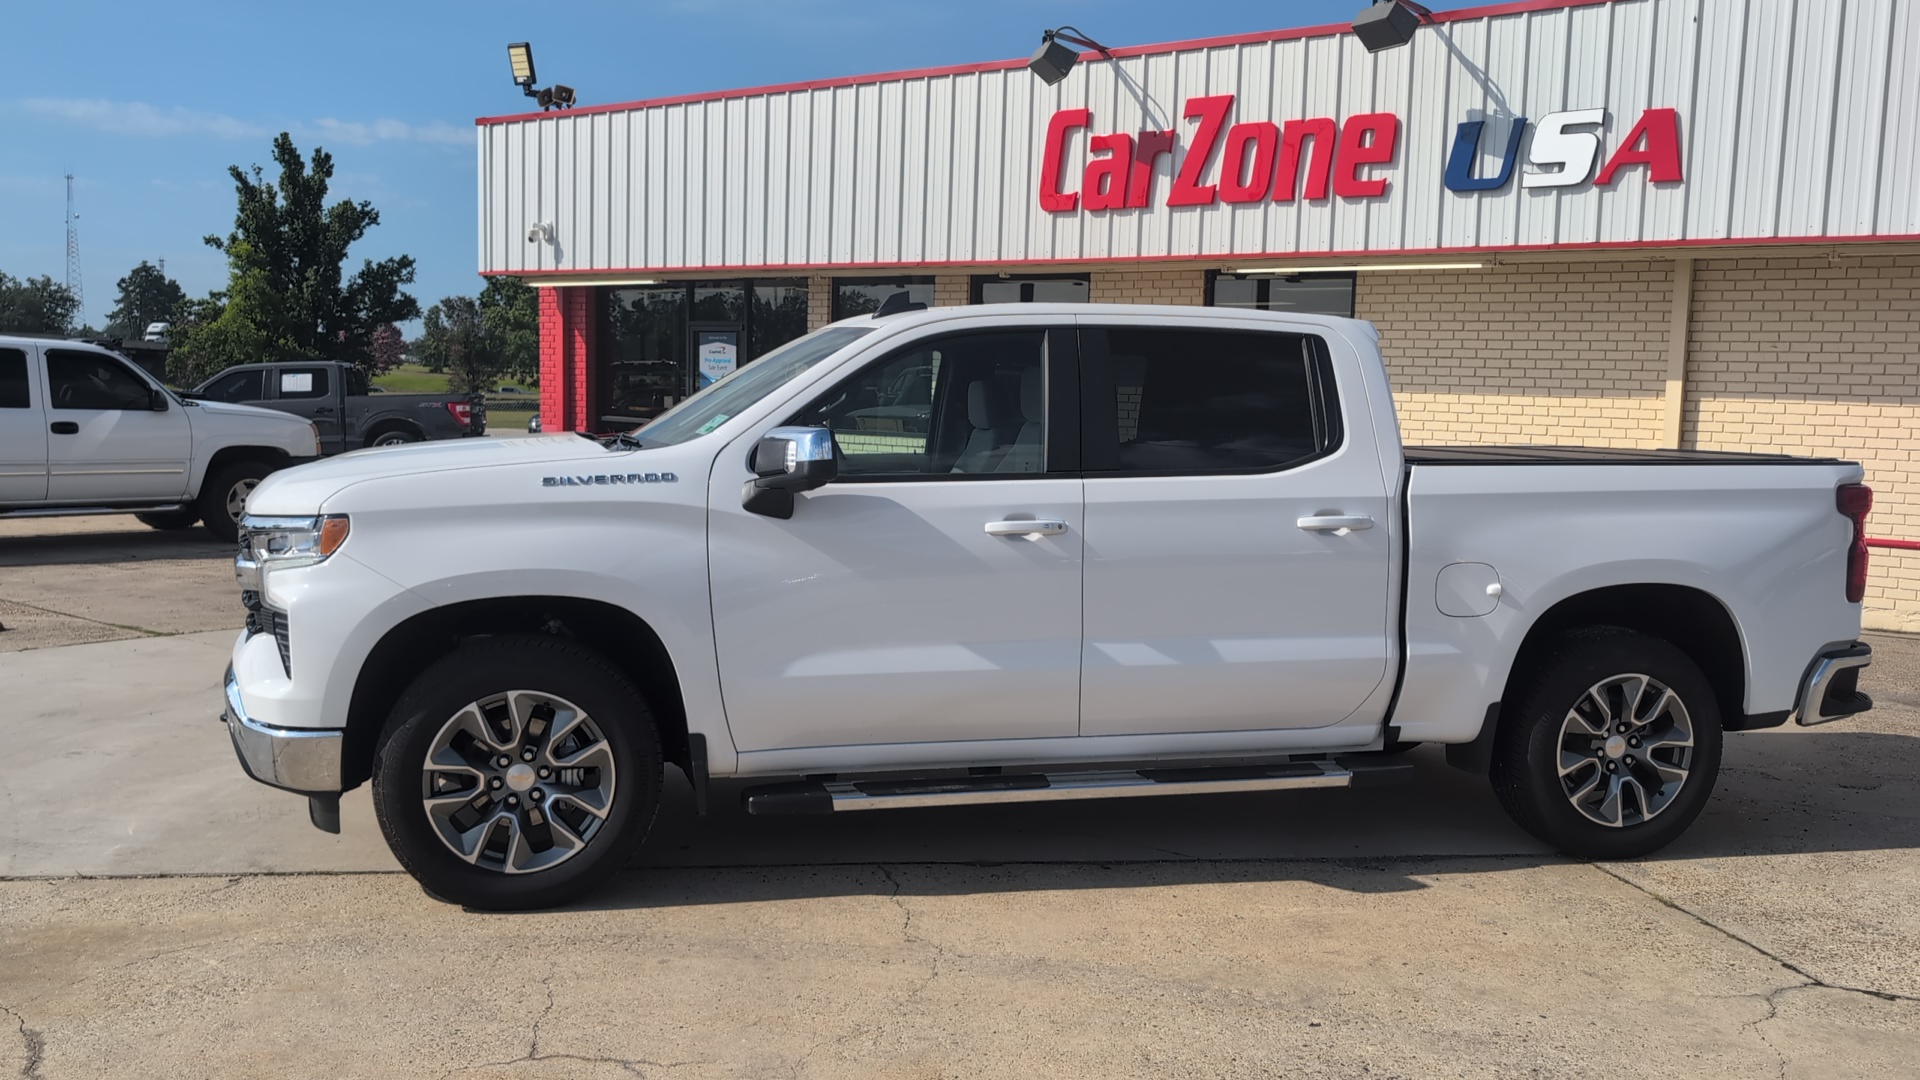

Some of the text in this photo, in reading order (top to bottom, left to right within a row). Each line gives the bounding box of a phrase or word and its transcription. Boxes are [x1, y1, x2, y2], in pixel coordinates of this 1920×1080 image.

[1039, 95, 1684, 213] CarZone USA
[541, 472, 679, 488] SILVERADO
